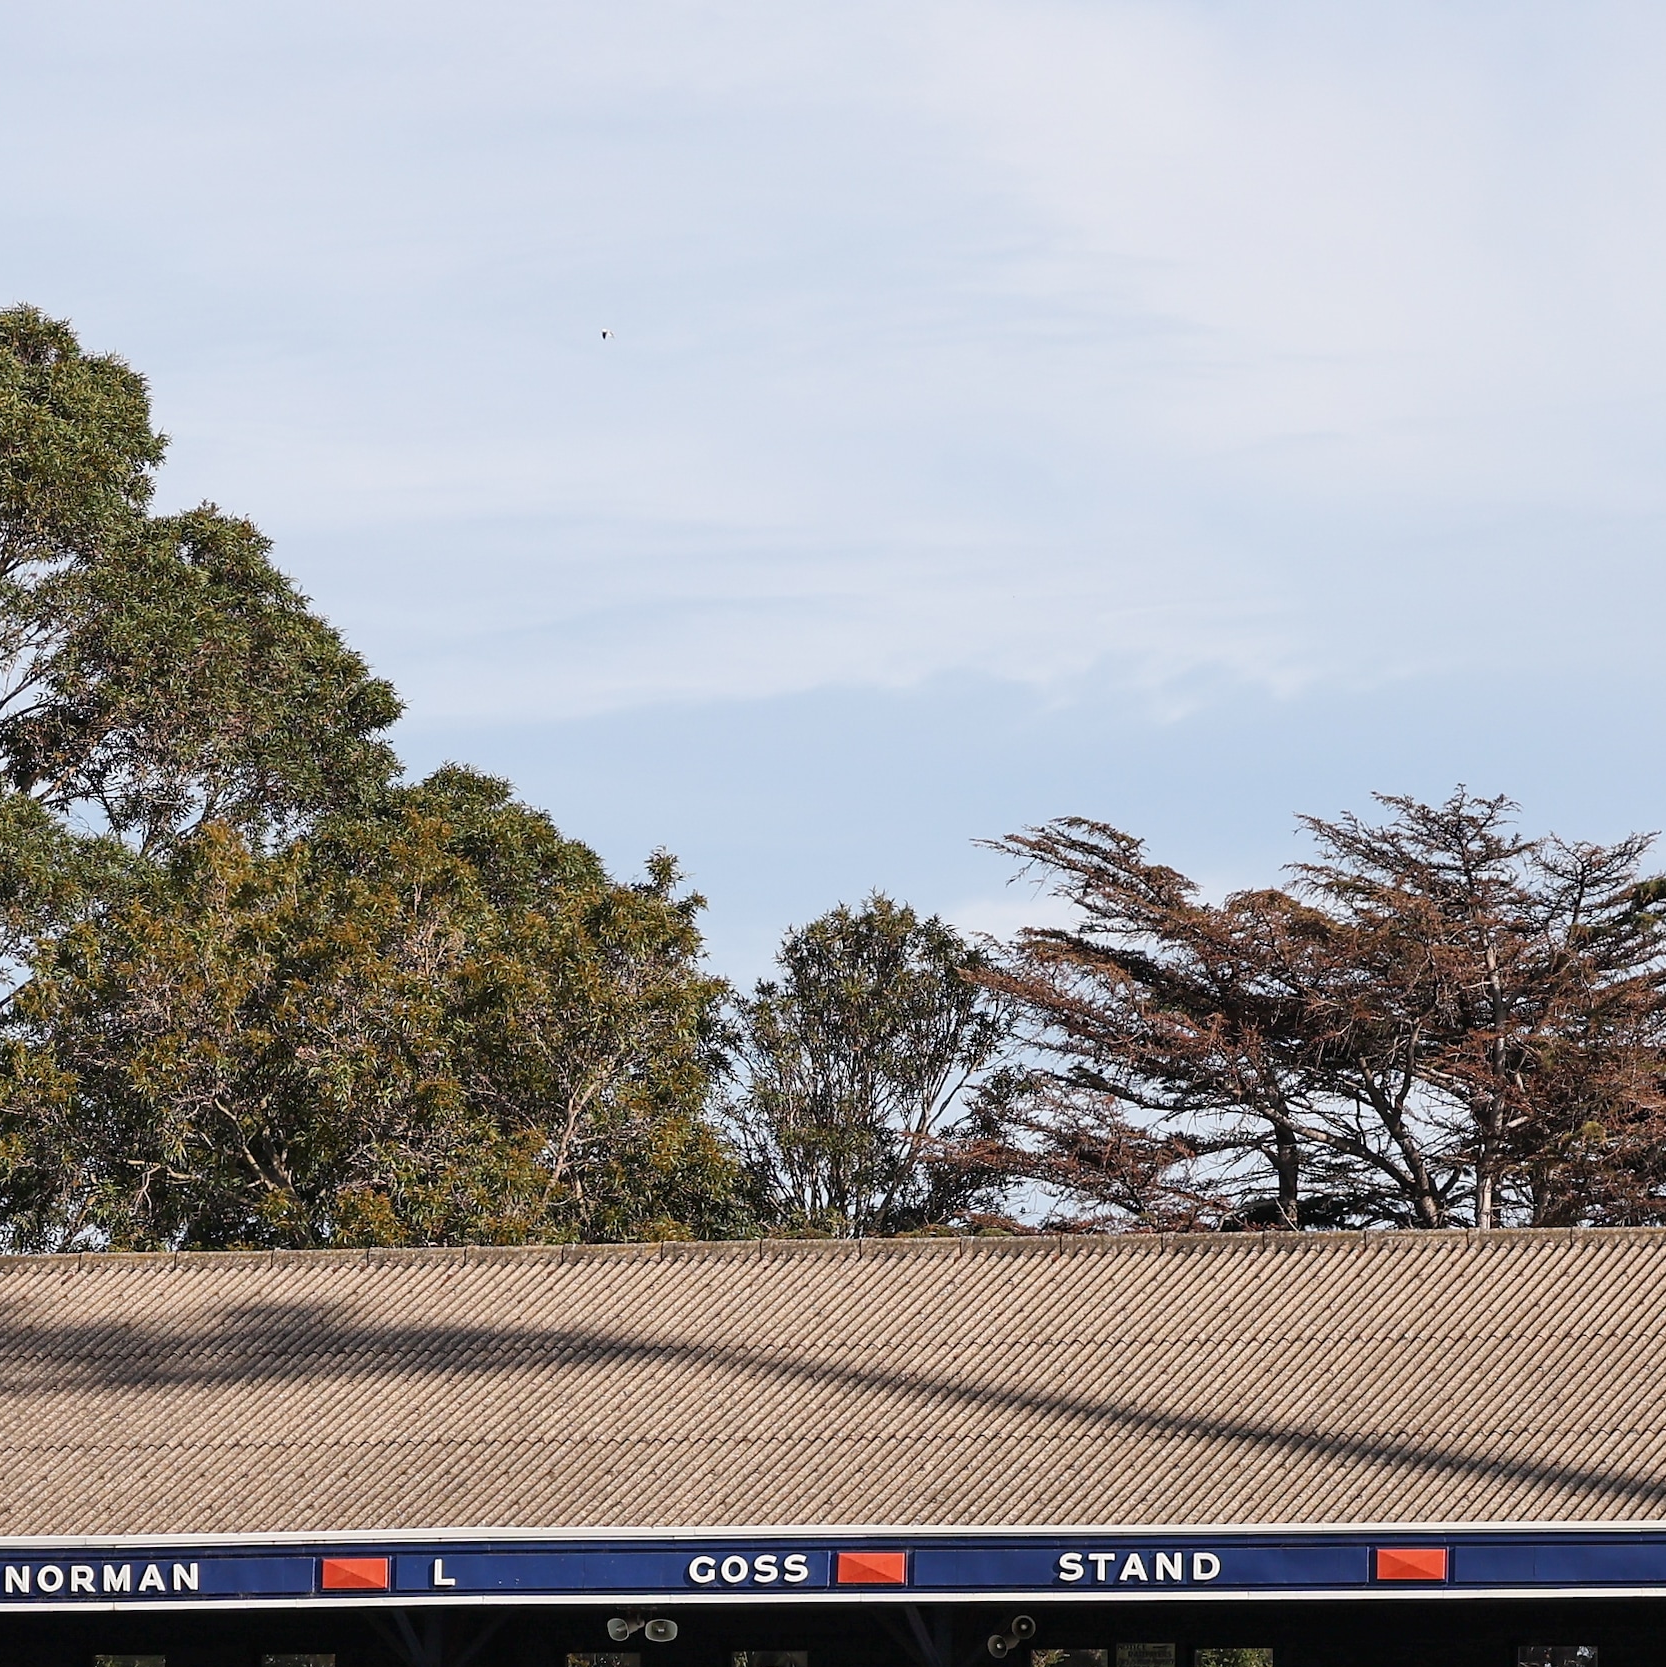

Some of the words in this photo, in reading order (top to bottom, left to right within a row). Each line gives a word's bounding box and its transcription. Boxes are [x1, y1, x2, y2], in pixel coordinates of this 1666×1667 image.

[4, 1562, 199, 1594] NORMAN
[434, 1558, 456, 1587] L
[688, 1554, 809, 1584] GOSS
[1058, 1551, 1221, 1582] STAND
